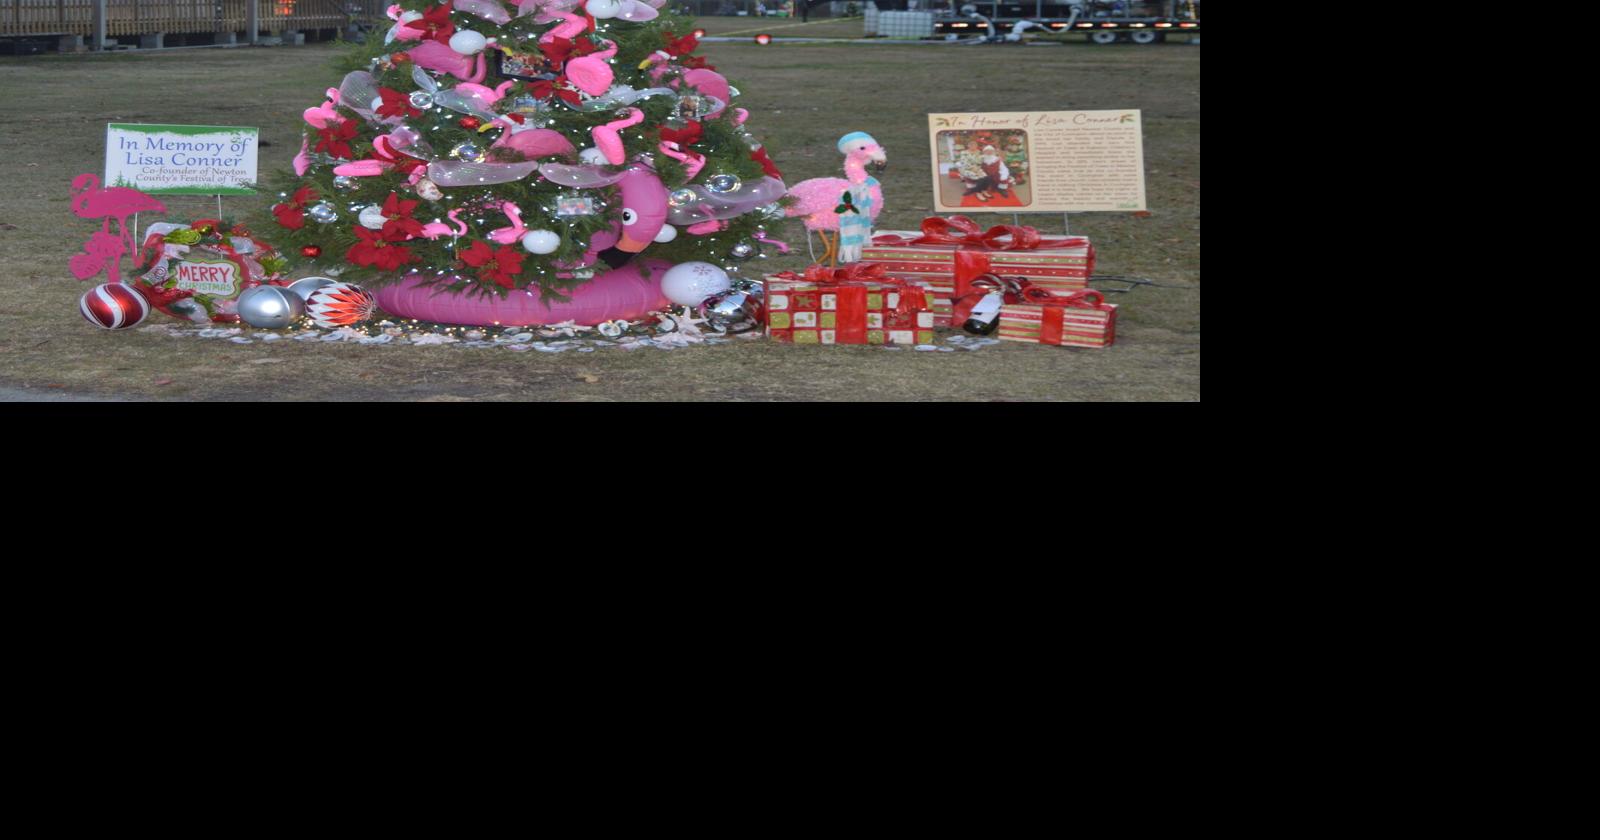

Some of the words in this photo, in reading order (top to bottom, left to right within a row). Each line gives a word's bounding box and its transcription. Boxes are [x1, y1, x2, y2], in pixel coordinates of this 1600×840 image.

[971, 114, 1010, 128] Honor
[1015, 114, 1029, 128] of
[1035, 113, 1065, 126] Lisa
[120, 136, 138, 150] In
[146, 137, 224, 156] Memory
[230, 137, 252, 156] of
[126, 152, 163, 166] Lisa
[171, 152, 242, 167] Conner
[142, 166, 196, 175] Co-founder
[200, 167, 210, 175] of
[212, 167, 247, 175] Newton
[135, 174, 177, 183] County's
[180, 174, 215, 182] Festival
[217, 174, 227, 183] of
[178, 265, 230, 283] MERRY
[178, 282, 232, 291] CHRISTMAS
